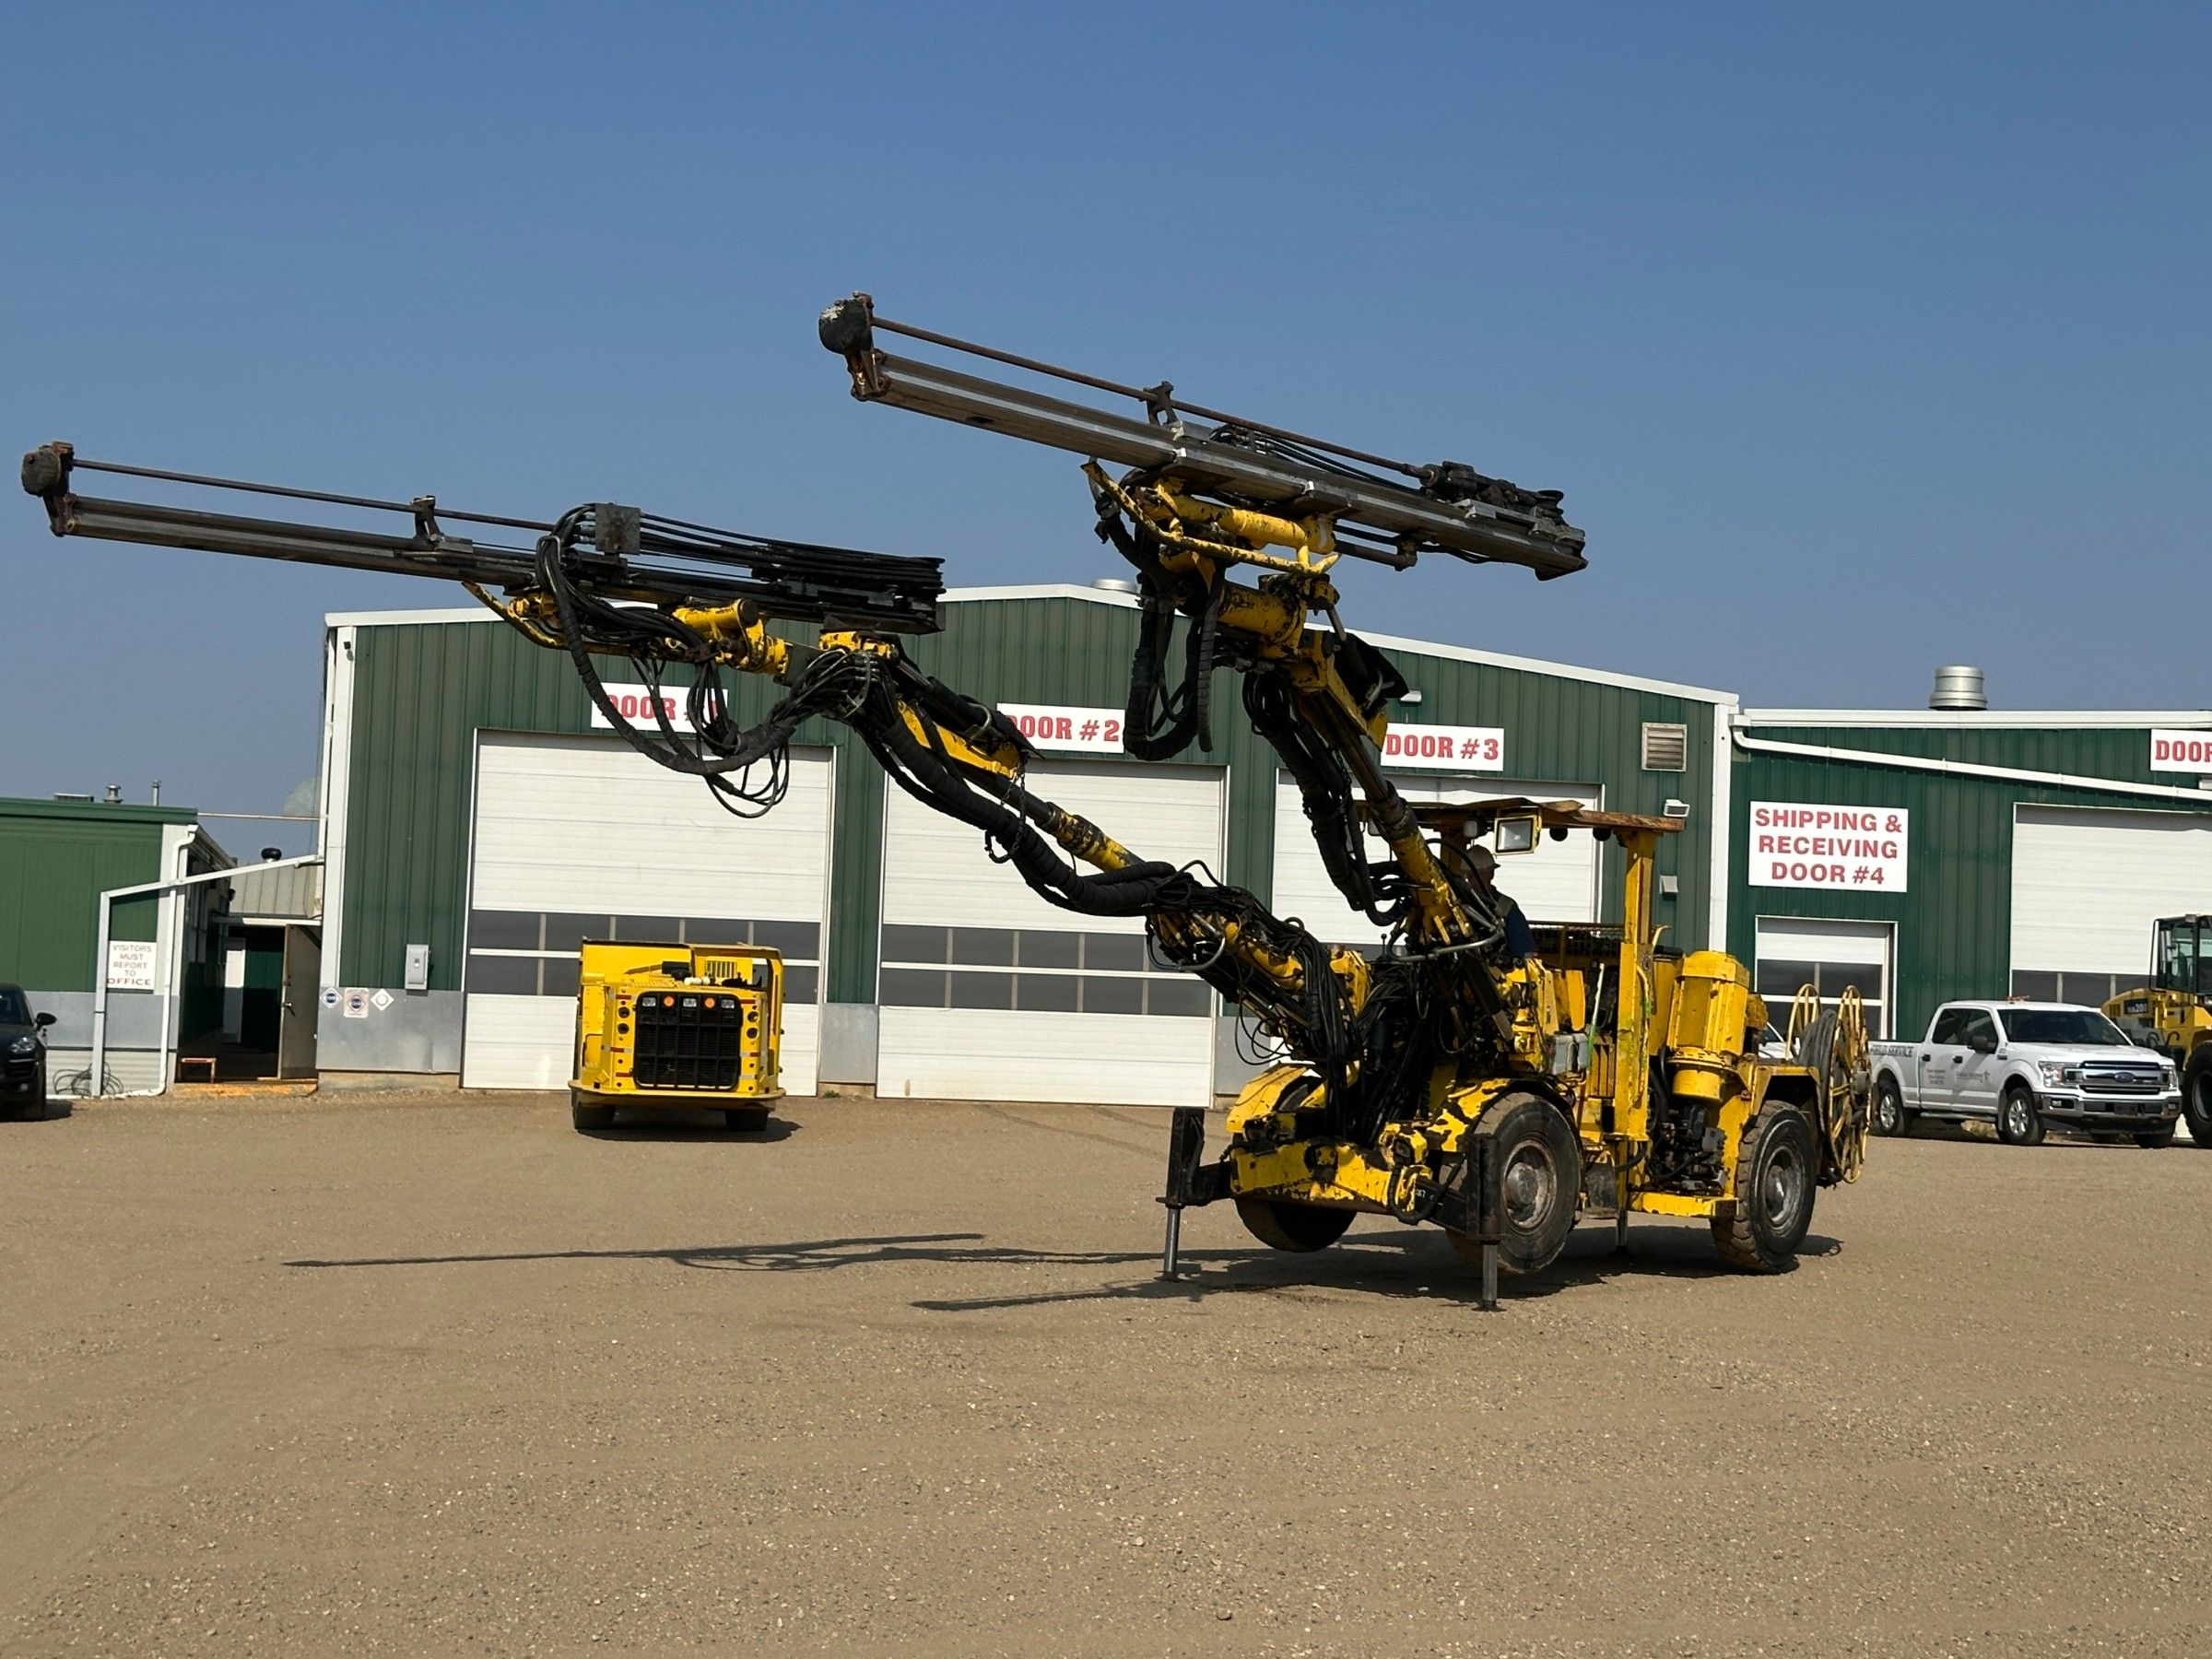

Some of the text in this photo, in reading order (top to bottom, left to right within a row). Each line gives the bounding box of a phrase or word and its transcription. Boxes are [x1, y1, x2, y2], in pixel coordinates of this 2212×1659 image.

[1079, 719, 1120, 742] #2
[1385, 734, 1499, 760] DOOR #3
[1755, 807, 1902, 833] SHIPPING &
[1759, 834, 1898, 859] RECEIVING
[1771, 862, 1885, 885] DOOR #4
